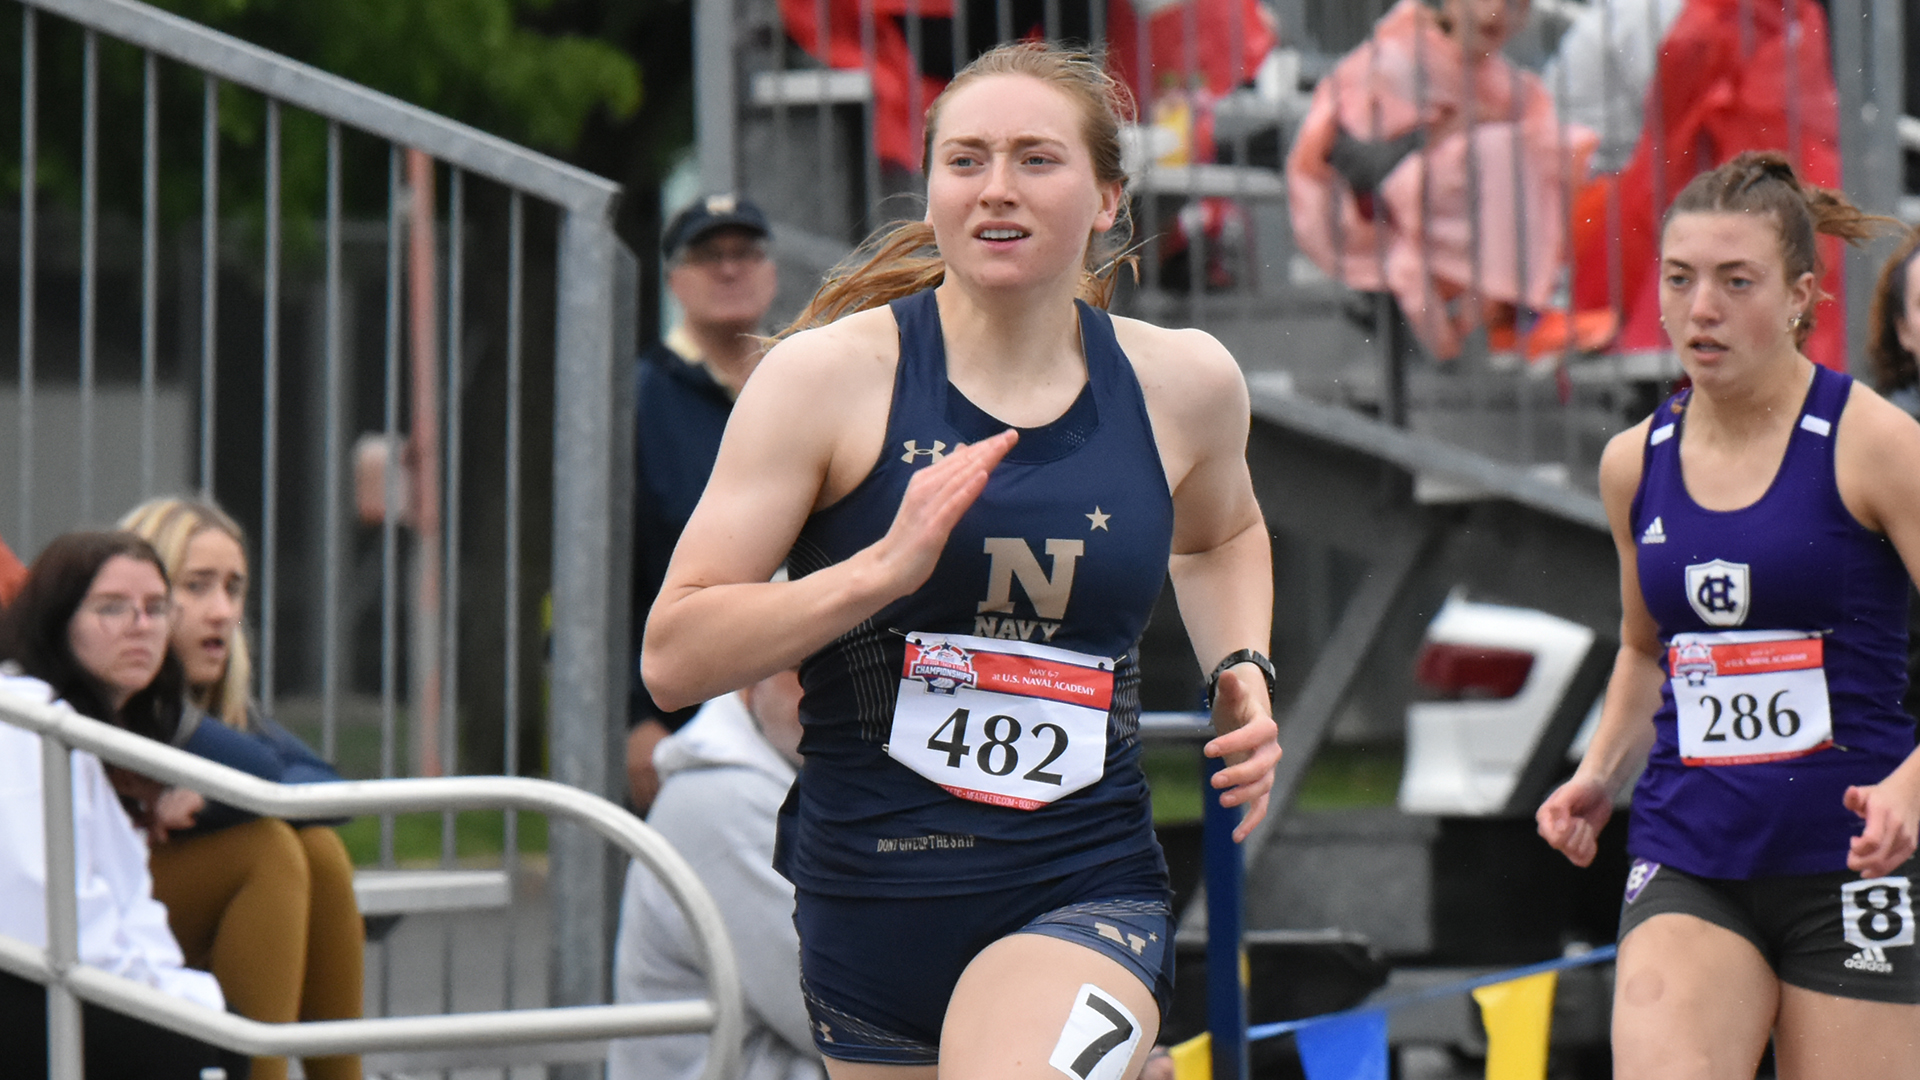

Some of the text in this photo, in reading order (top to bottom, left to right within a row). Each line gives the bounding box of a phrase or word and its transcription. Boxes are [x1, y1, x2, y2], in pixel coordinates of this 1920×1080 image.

[977, 537, 1085, 620] N
[972, 616, 1062, 643] NAVY
[915, 664, 973, 683] CHAMPIONSHIPS
[1002, 673, 1020, 684] U.S.
[1022, 676, 1052, 688] NAVAL
[1053, 681, 1096, 696] ACADEMY
[1029, 668, 1046, 676] MAY
[1699, 689, 1801, 743] 286
[927, 708, 1069, 786] 482
[928, 835, 949, 849] THE
[1853, 885, 1903, 941] 8
[1844, 958, 1893, 973] adidas
[1069, 992, 1134, 1080] 7
